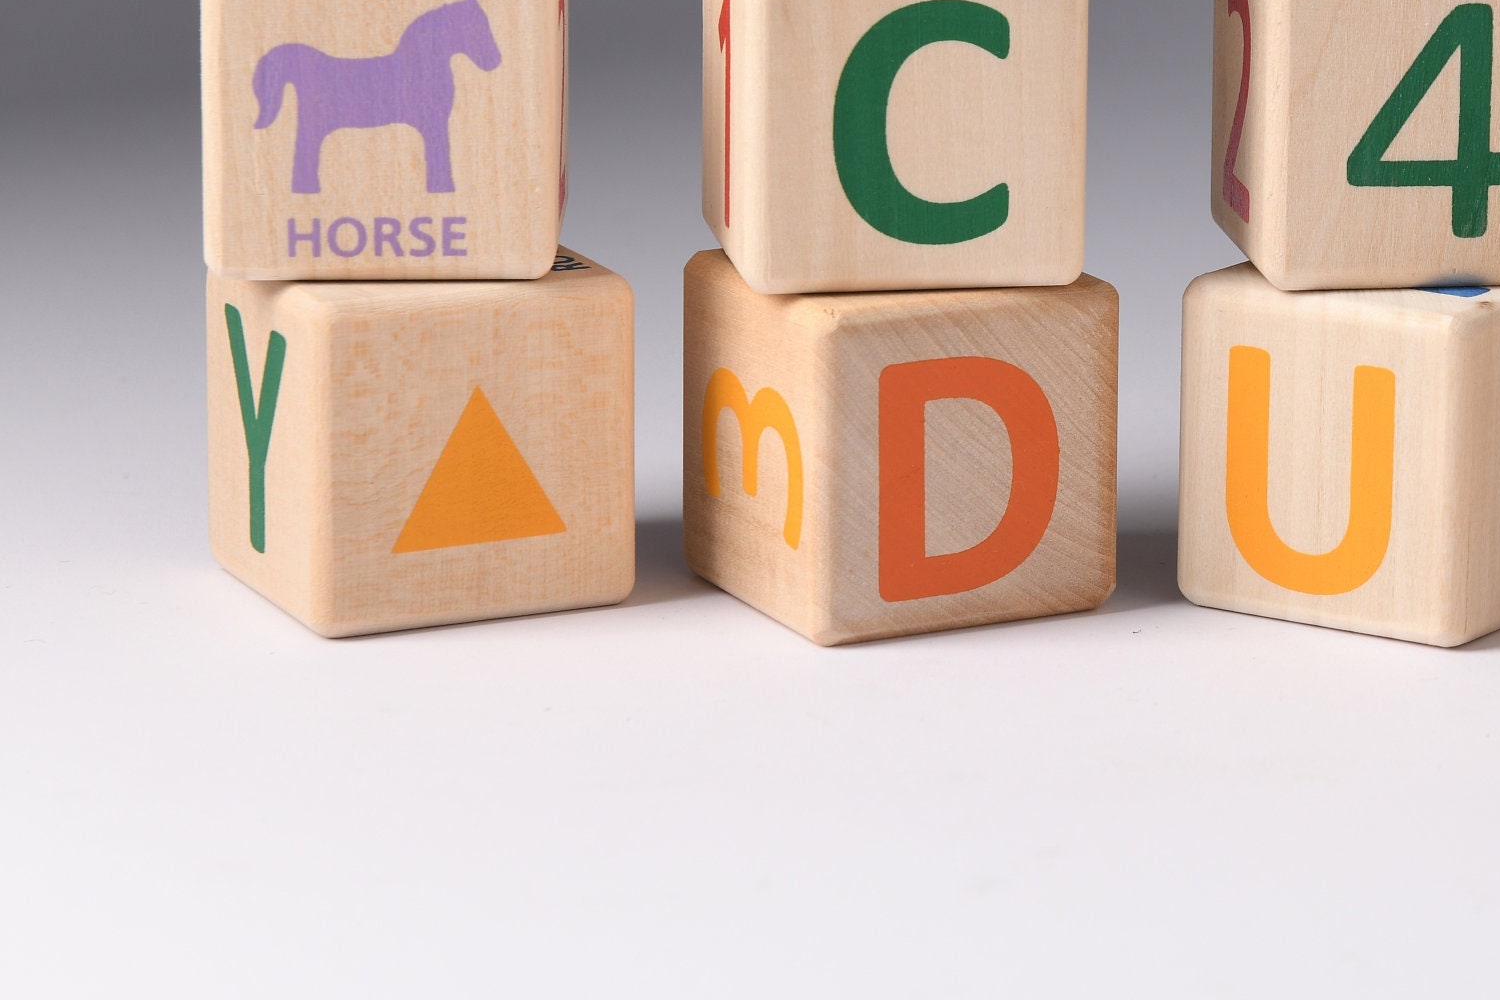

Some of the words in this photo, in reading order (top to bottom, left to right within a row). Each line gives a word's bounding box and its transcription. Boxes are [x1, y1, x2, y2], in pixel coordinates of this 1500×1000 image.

[286, 216, 468, 258] HORSE
[225, 303, 287, 553] Y
[879, 356, 1060, 603] D
[1225, 345, 1396, 596] U
